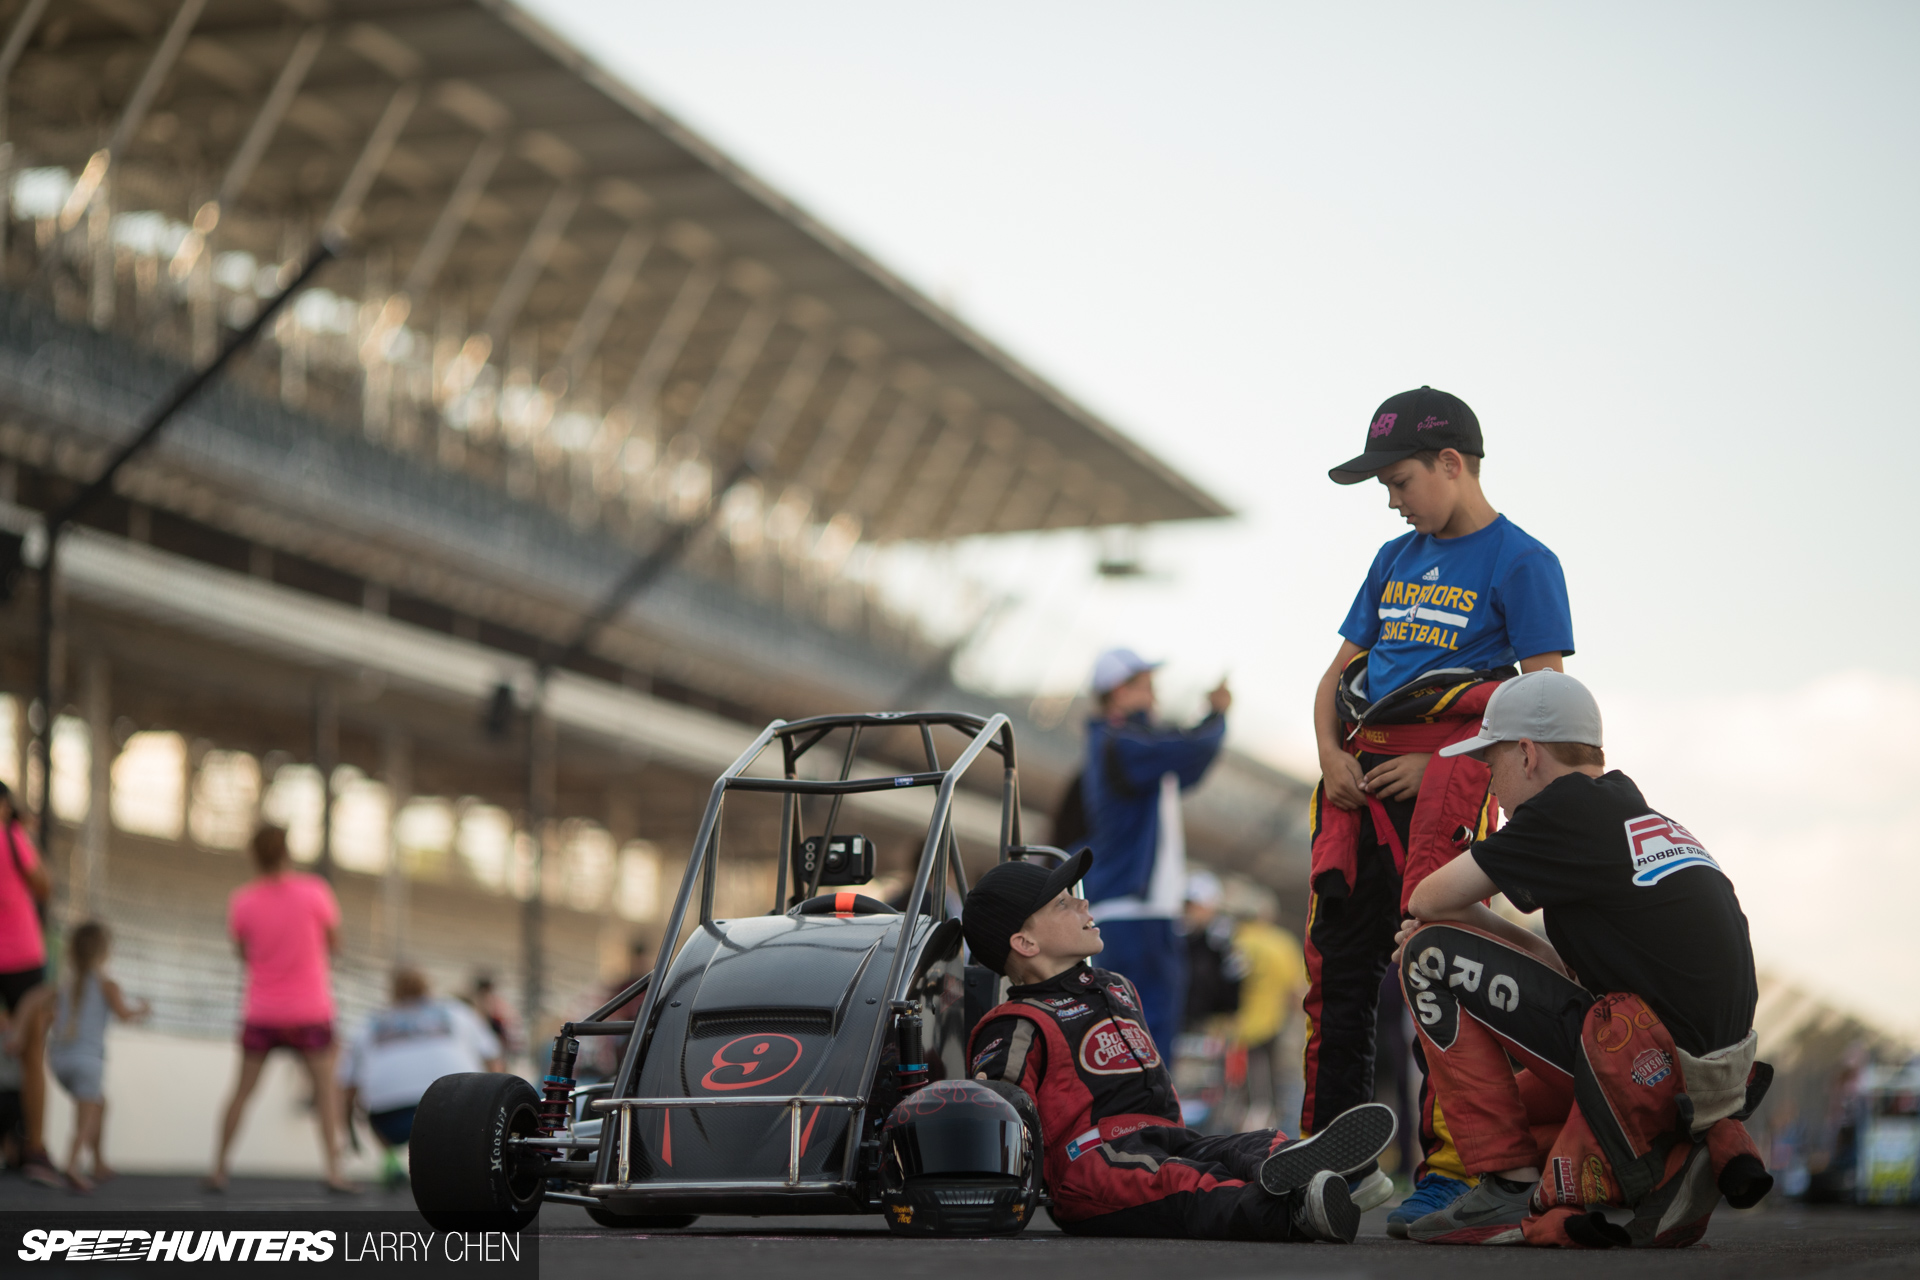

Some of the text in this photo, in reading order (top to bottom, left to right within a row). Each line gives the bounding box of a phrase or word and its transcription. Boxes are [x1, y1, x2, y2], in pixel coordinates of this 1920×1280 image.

[1381, 621, 1459, 651] SKETBALL
[1637, 847, 1685, 866] ROBBIE
[1639, 1056, 1664, 1077] USAC
[1560, 1158, 1575, 1193] Honda
[934, 1190, 998, 1204] RANDALL
